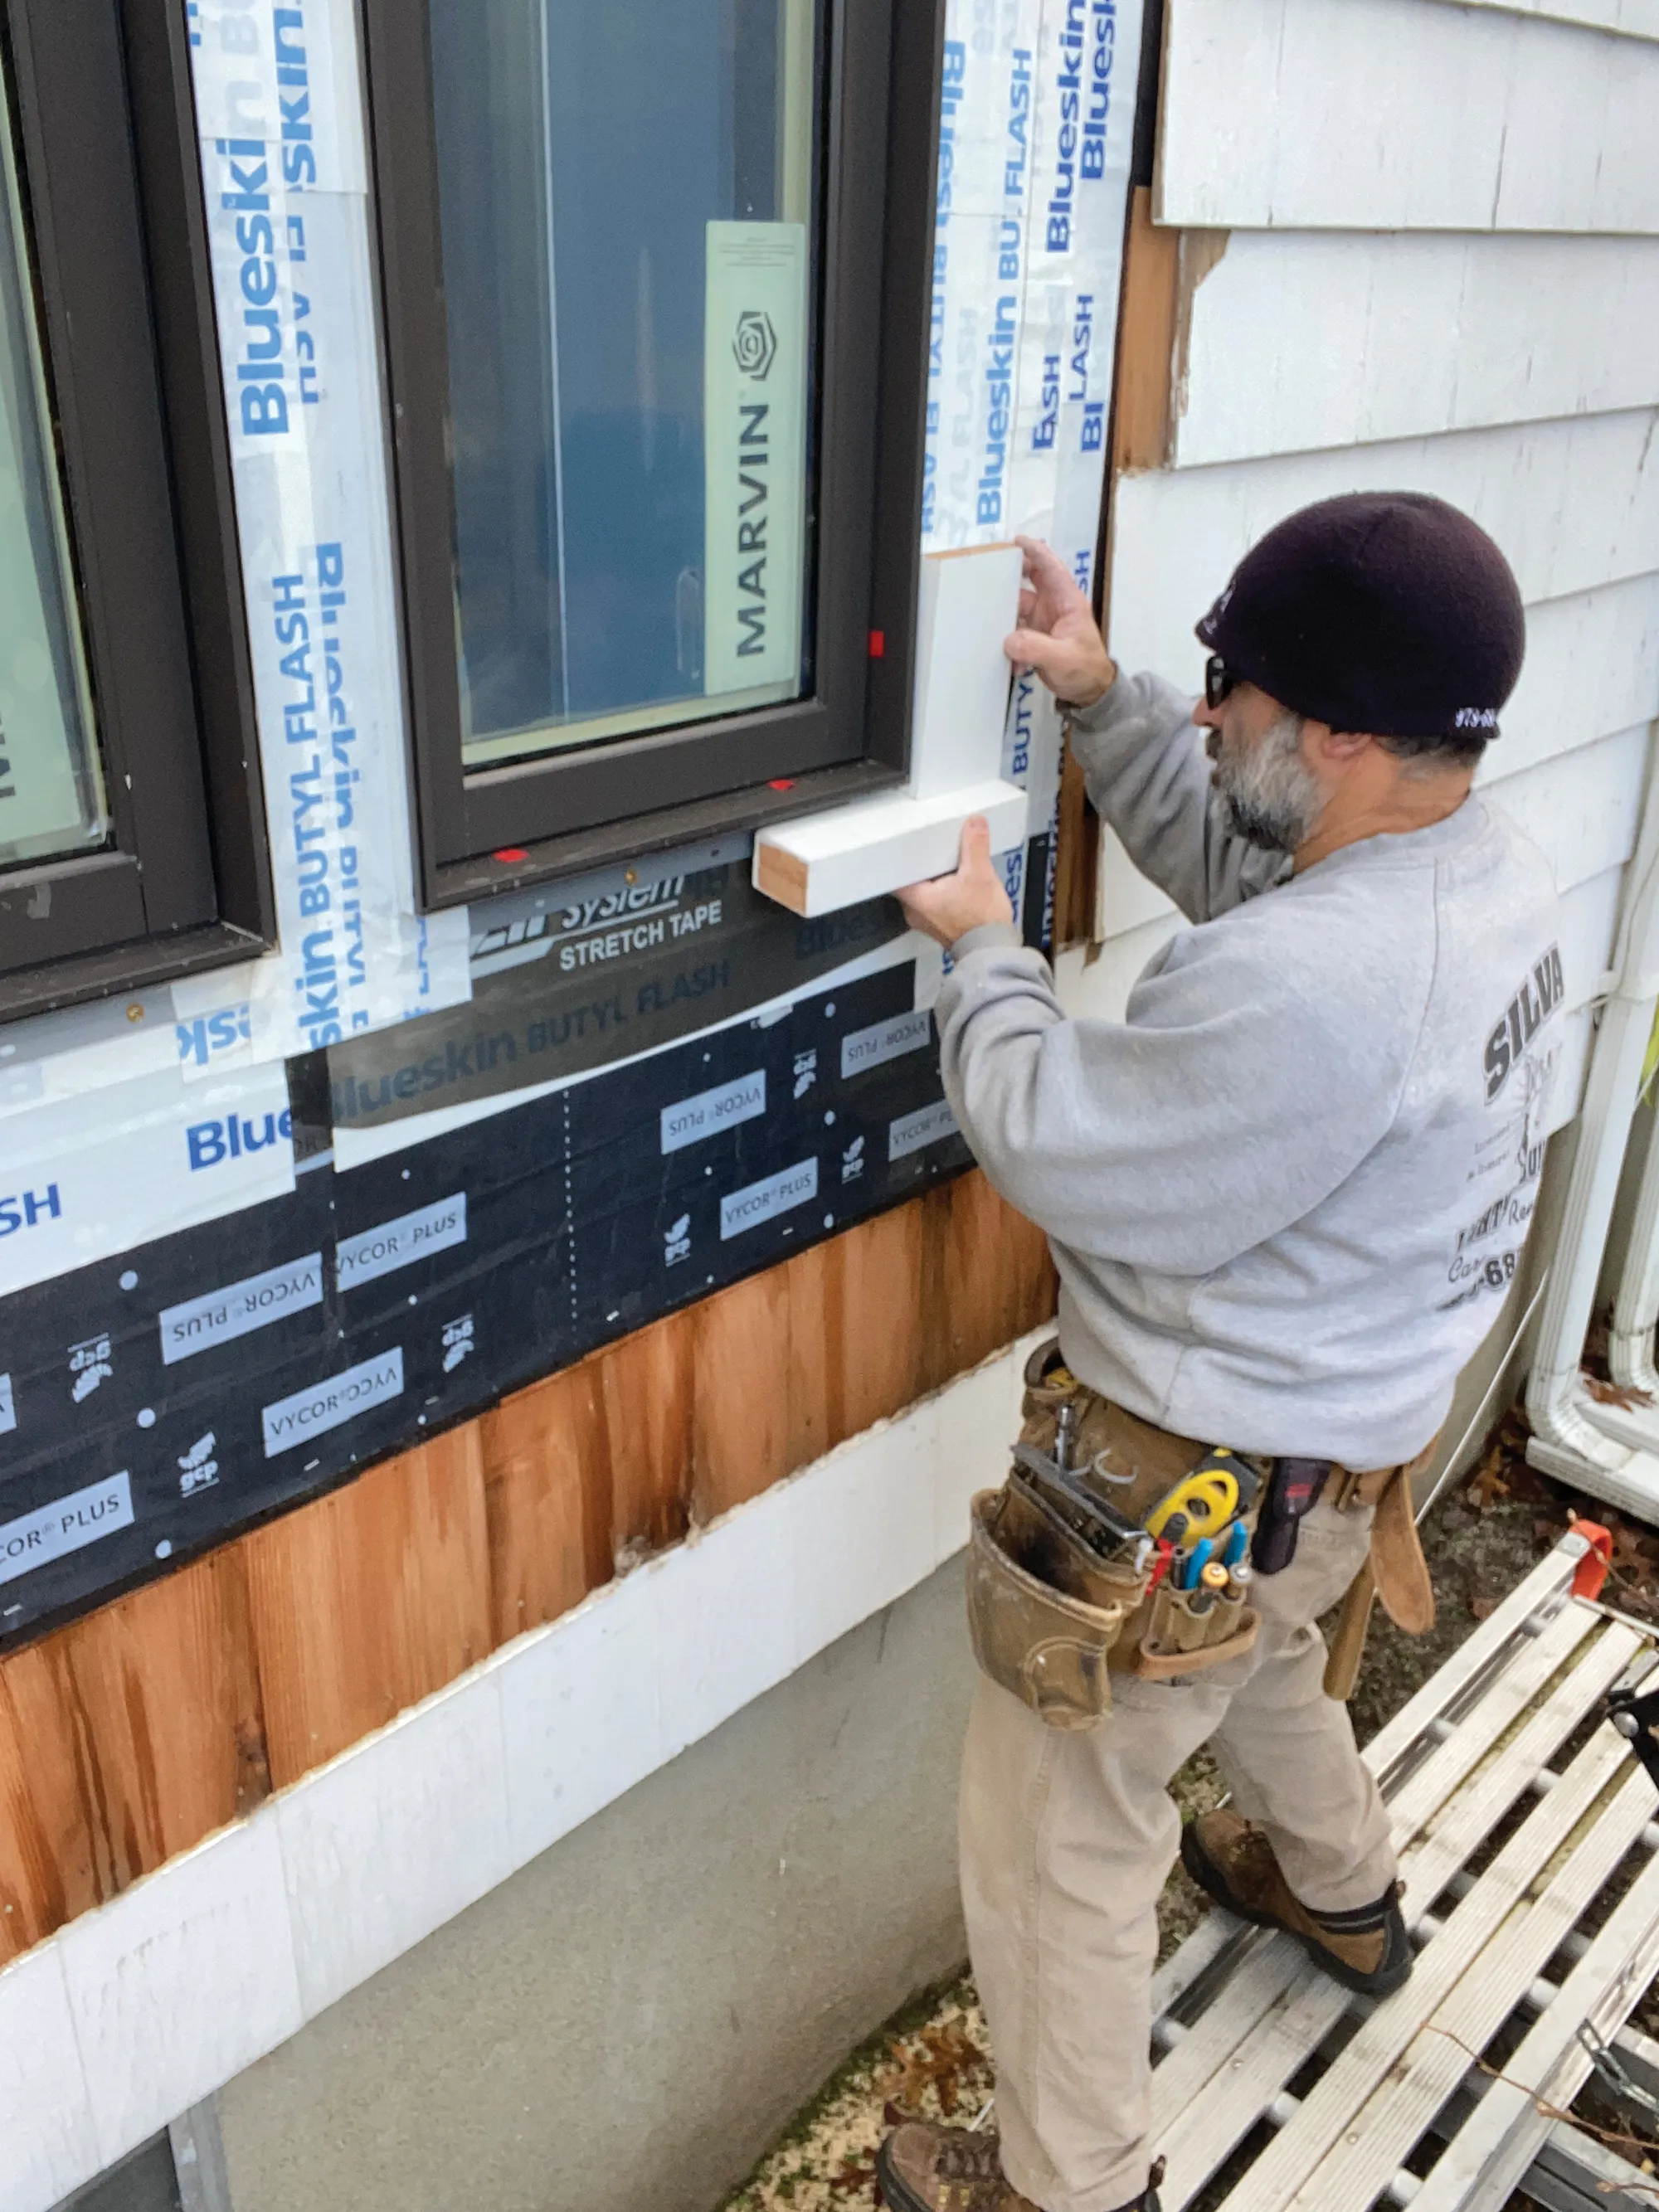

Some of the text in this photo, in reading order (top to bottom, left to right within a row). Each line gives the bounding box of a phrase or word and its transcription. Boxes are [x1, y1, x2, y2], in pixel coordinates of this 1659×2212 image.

[273, 7, 316, 192] skin
[1004, 48, 1032, 196] FLASH
[1046, 0, 1085, 252] Blueskin
[976, 295, 1017, 526] Blueskin
[737, 403, 770, 659] MARVIN
[271, 574, 317, 745] FLASH
[1012, 667, 1034, 775] BUTY
[290, 753, 331, 917] BUTYL
[559, 918, 664, 972] STRETCH
[668, 899, 722, 938] TAPE
[1483, 943, 1564, 1105] SILVA
[668, 1112, 705, 1136] PLUS
[412, 1213, 457, 1244] PLUS
[778, 1173, 813, 1198] PLUS
[69, 1339, 113, 1371] gcp
[173, 1304, 228, 1344] PLUS
[61, 1493, 120, 1535] PLUS
[179, 1461, 220, 1491] gcp
